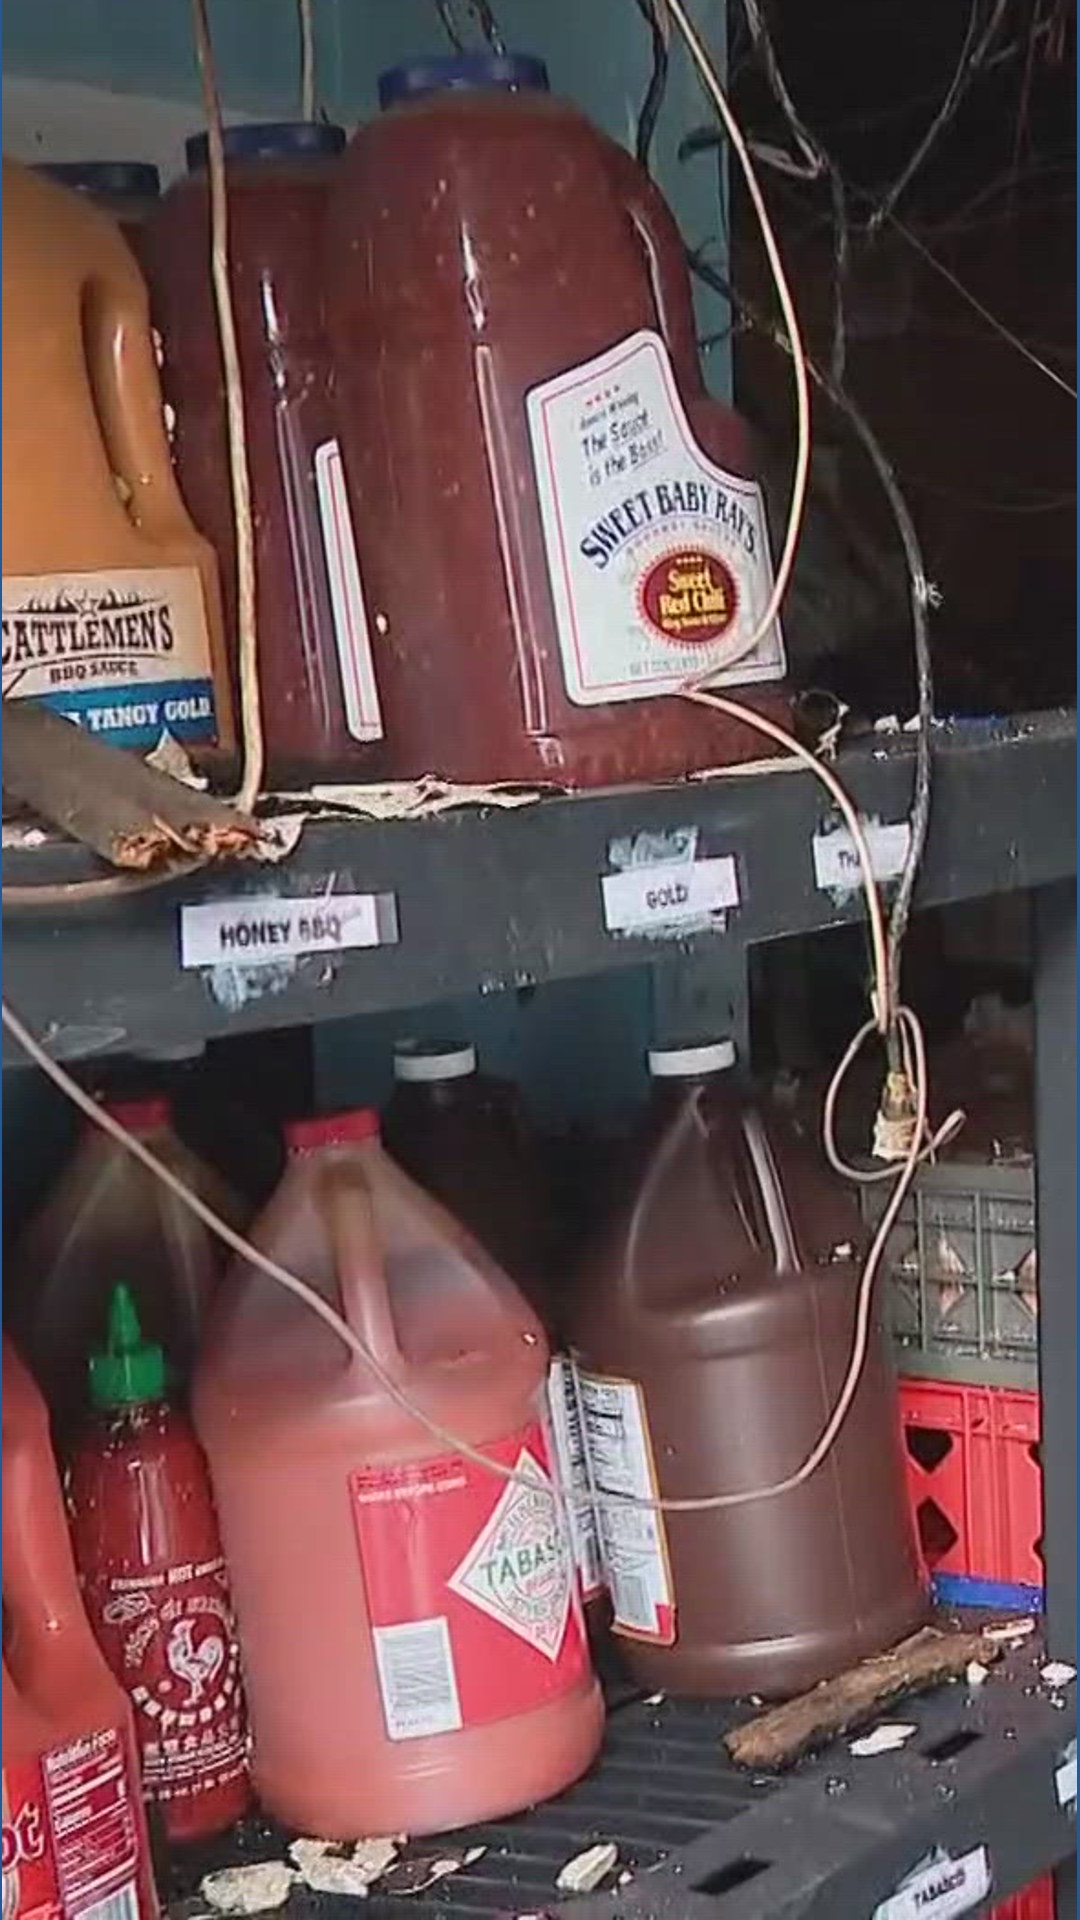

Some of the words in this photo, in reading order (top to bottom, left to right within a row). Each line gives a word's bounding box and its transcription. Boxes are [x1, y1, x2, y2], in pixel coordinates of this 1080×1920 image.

[583, 432, 608, 458] The
[579, 490, 653, 570] SWEET
[654, 480, 711, 516] BABY
[714, 489, 758, 554] RAY'S
[667, 562, 714, 593] Sweet
[658, 588, 691, 615] Red
[2, 604, 173, 666] CATTLEMENS
[50, 663, 88, 684] BBQ
[90, 660, 139, 676] SAUCE
[87, 703, 158, 732] TANGY
[164, 696, 210, 719] GOLD
[646, 882, 689, 910] GOLD
[220, 919, 291, 949] HONEY
[298, 915, 342, 943] BBQ
[913, 1867, 967, 1907] TABASCO
